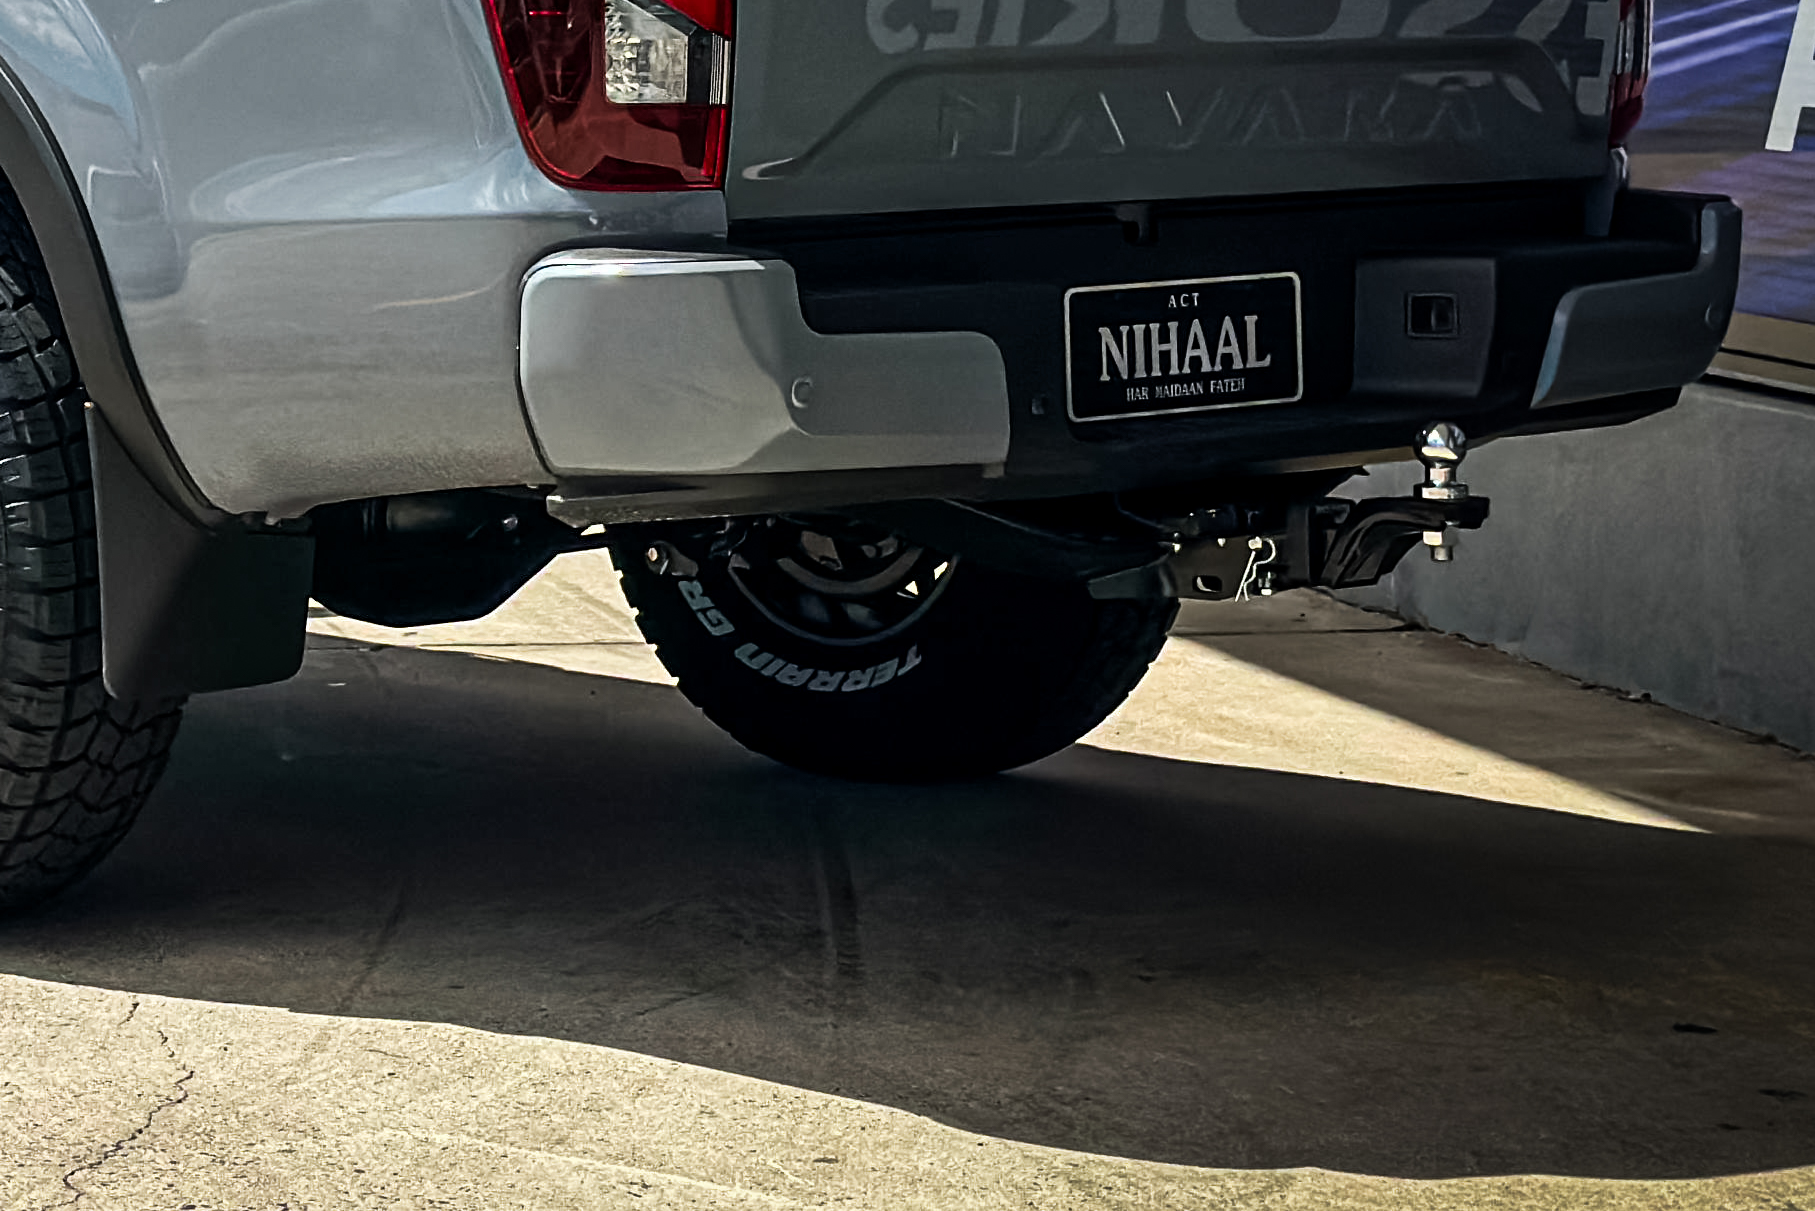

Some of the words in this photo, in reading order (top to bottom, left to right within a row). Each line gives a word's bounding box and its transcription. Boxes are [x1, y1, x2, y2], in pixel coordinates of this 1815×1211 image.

[938, 84, 1482, 157] NAVARA
[1168, 292, 1200, 309] ACT
[1098, 315, 1271, 382] NIHAAL
[1126, 386, 1149, 402] HAR
[1210, 377, 1245, 394] FATEH
[734, 642, 922, 692] TERRAIN
